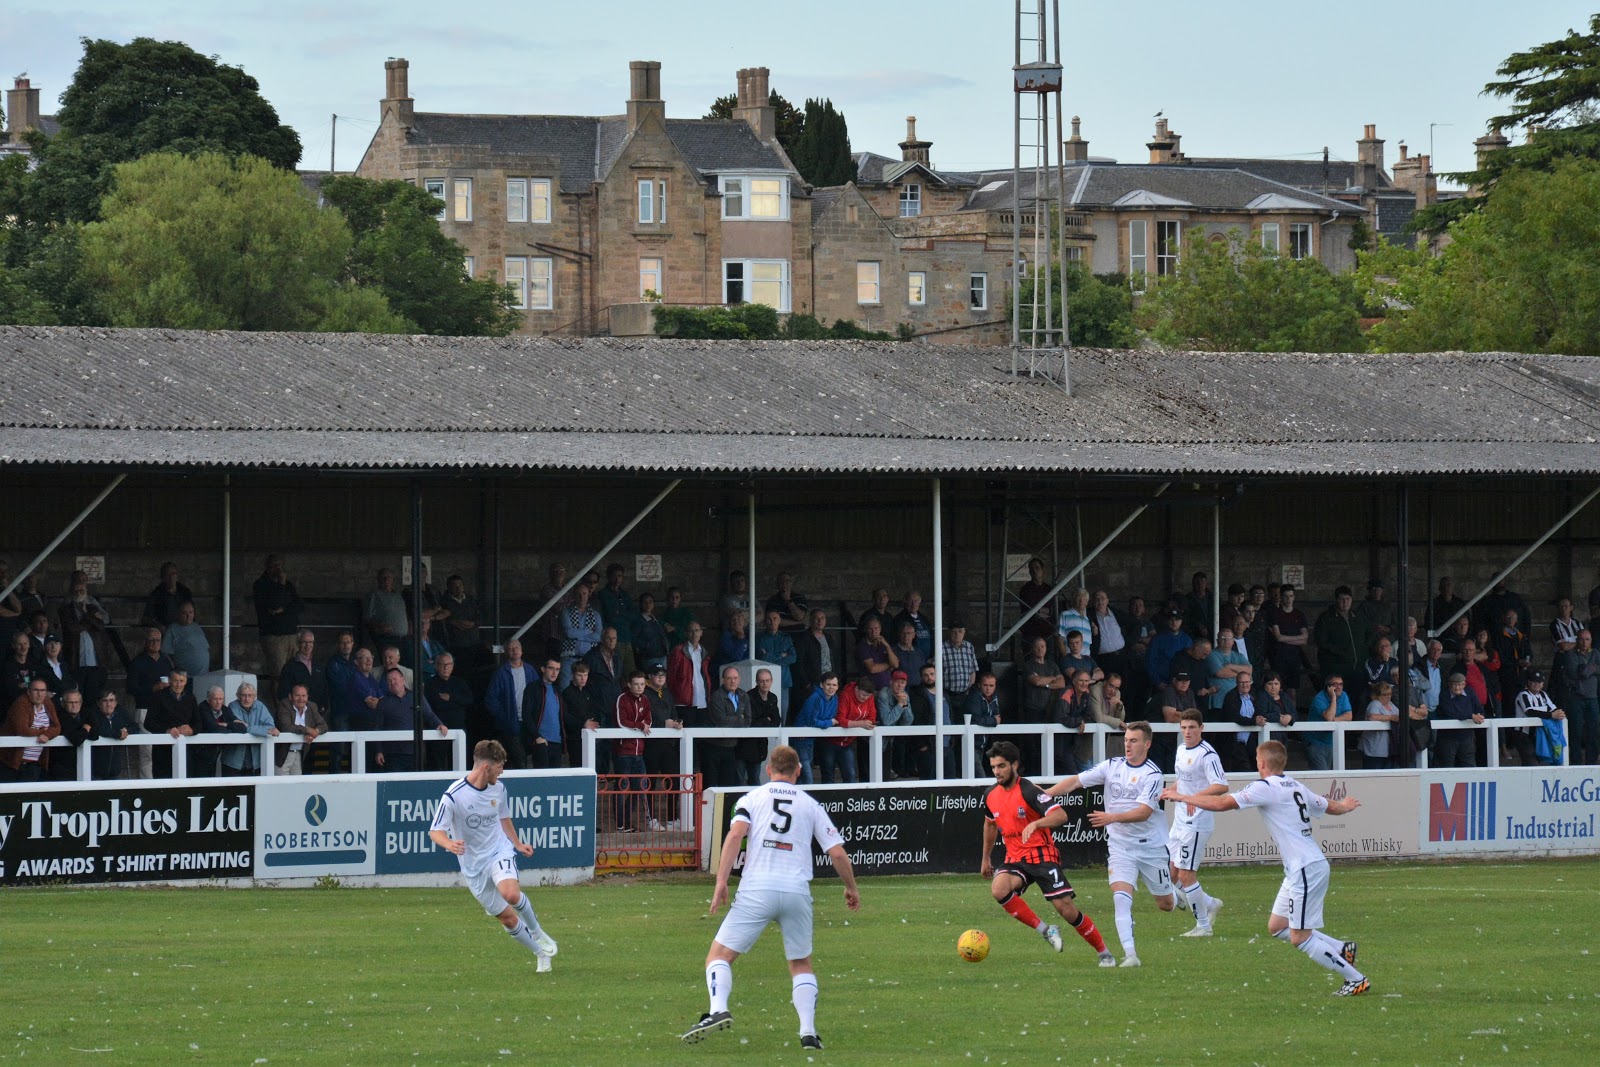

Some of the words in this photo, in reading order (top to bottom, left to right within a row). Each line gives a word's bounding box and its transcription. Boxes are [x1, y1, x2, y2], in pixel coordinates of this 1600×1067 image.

[769, 788, 797, 796] GRAHAM
[546, 794, 584, 817] THE
[847, 798, 876, 812] Sales
[878, 797, 887, 811] &
[889, 796, 928, 811] Service
[936, 794, 978, 812] Lifestyle
[1053, 792, 1084, 806] railers
[22, 798, 177, 848] Trophies
[187, 795, 250, 833] Ltd
[770, 798, 793, 834] 5
[855, 825, 898, 841] 547522
[1506, 813, 1595, 840] Industrial
[264, 830, 368, 849] ROBERTSON
[1204, 843, 1233, 860] ingle
[1236, 841, 1280, 859] Highla
[1321, 839, 1358, 854] Scotch
[1361, 837, 1403, 854] Whisky
[15, 856, 95, 877] AWARDS
[102, 855, 113, 873] T
[116, 854, 167, 873] SHIRT
[169, 850, 251, 871] PRINTING
[498, 858, 511, 870] 17
[1048, 868, 1059, 883] 7
[1158, 869, 1169, 884] 14
[1288, 898, 1294, 914] 8
